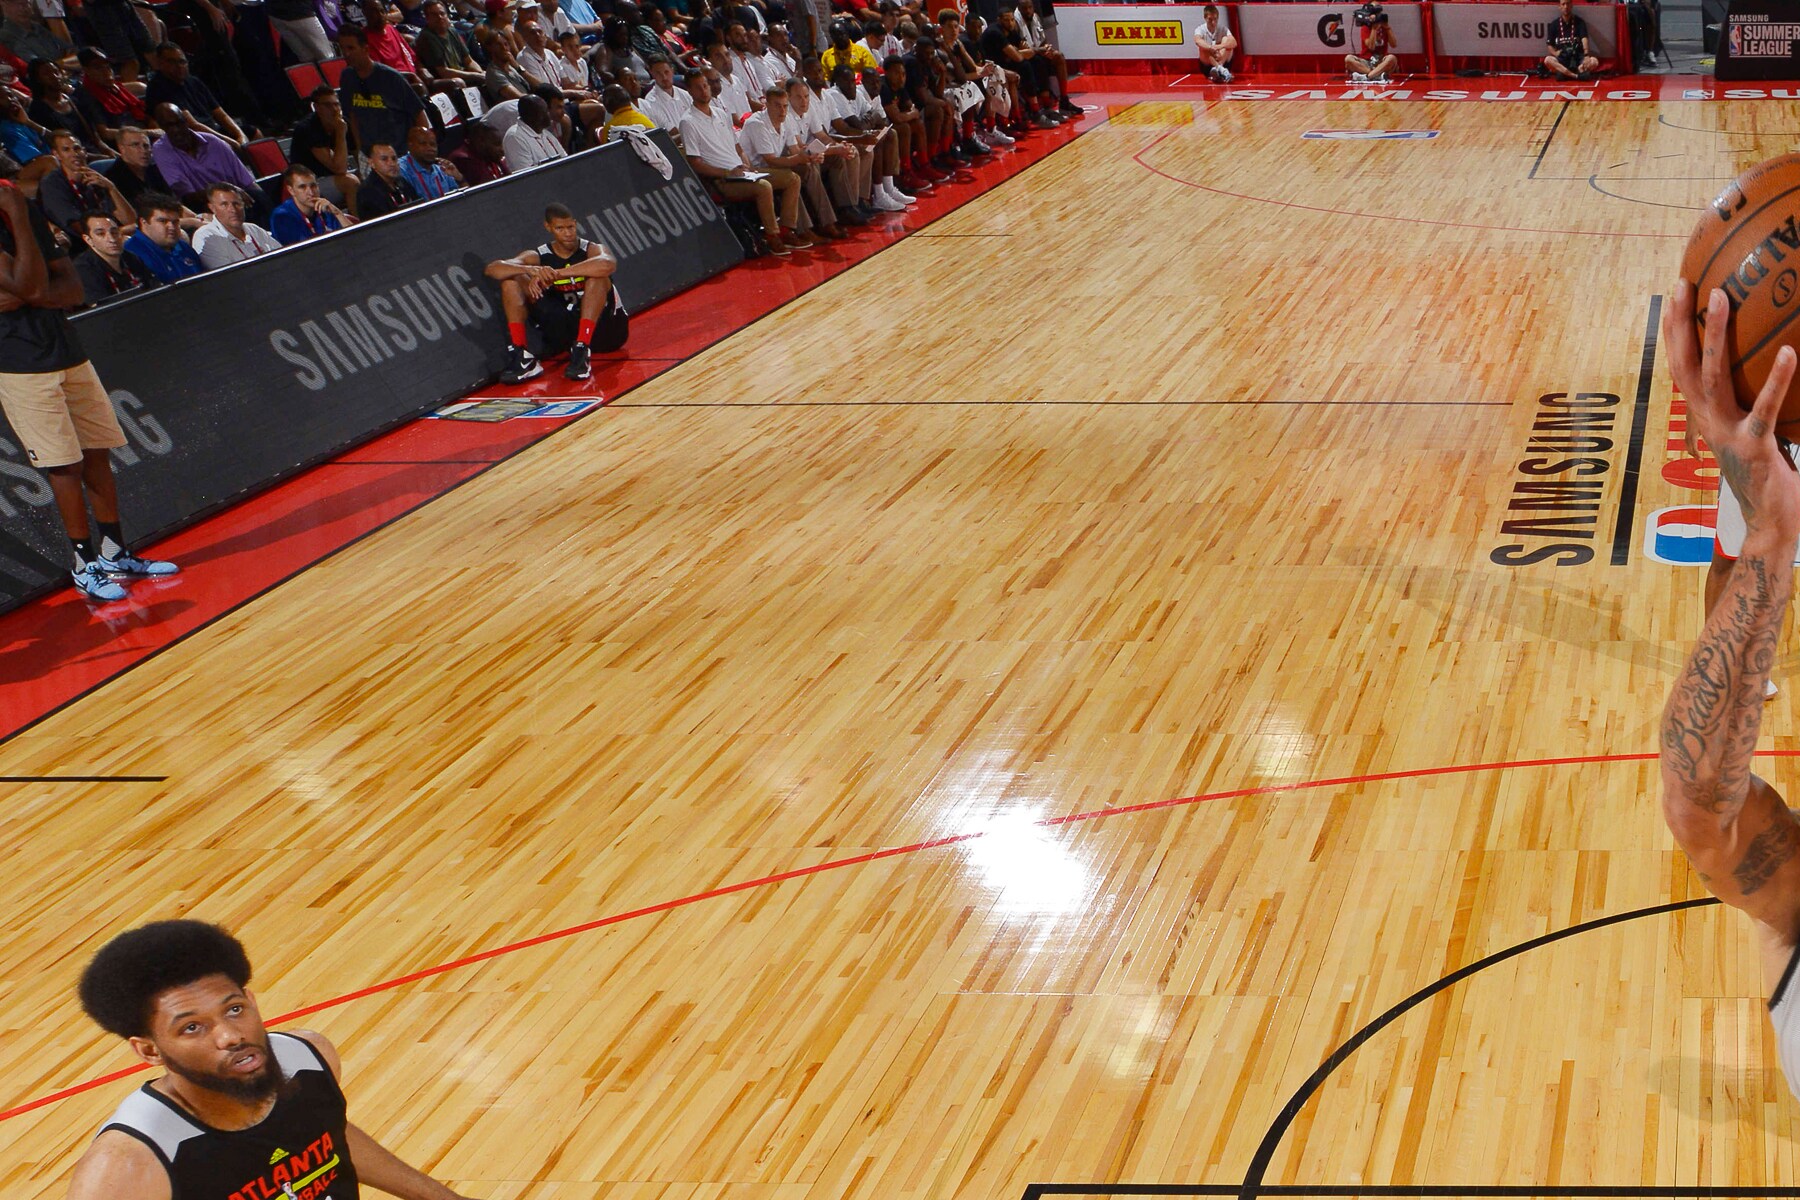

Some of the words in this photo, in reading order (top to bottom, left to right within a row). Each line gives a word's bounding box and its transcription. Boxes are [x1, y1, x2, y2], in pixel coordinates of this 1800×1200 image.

[1729, 14, 1769, 22] SAMSUNG
[1102, 26, 1178, 40] PANINI
[1478, 21, 1549, 39] SAMSU
[1743, 25, 1800, 40] SUMMER
[1743, 41, 1792, 55] LEAGUE
[1225, 89, 1652, 100] SAMSUNG
[576, 176, 717, 259] AMSUNG
[269, 264, 494, 391] SAMSUNG
[1489, 392, 1622, 567] SAMSUNG
